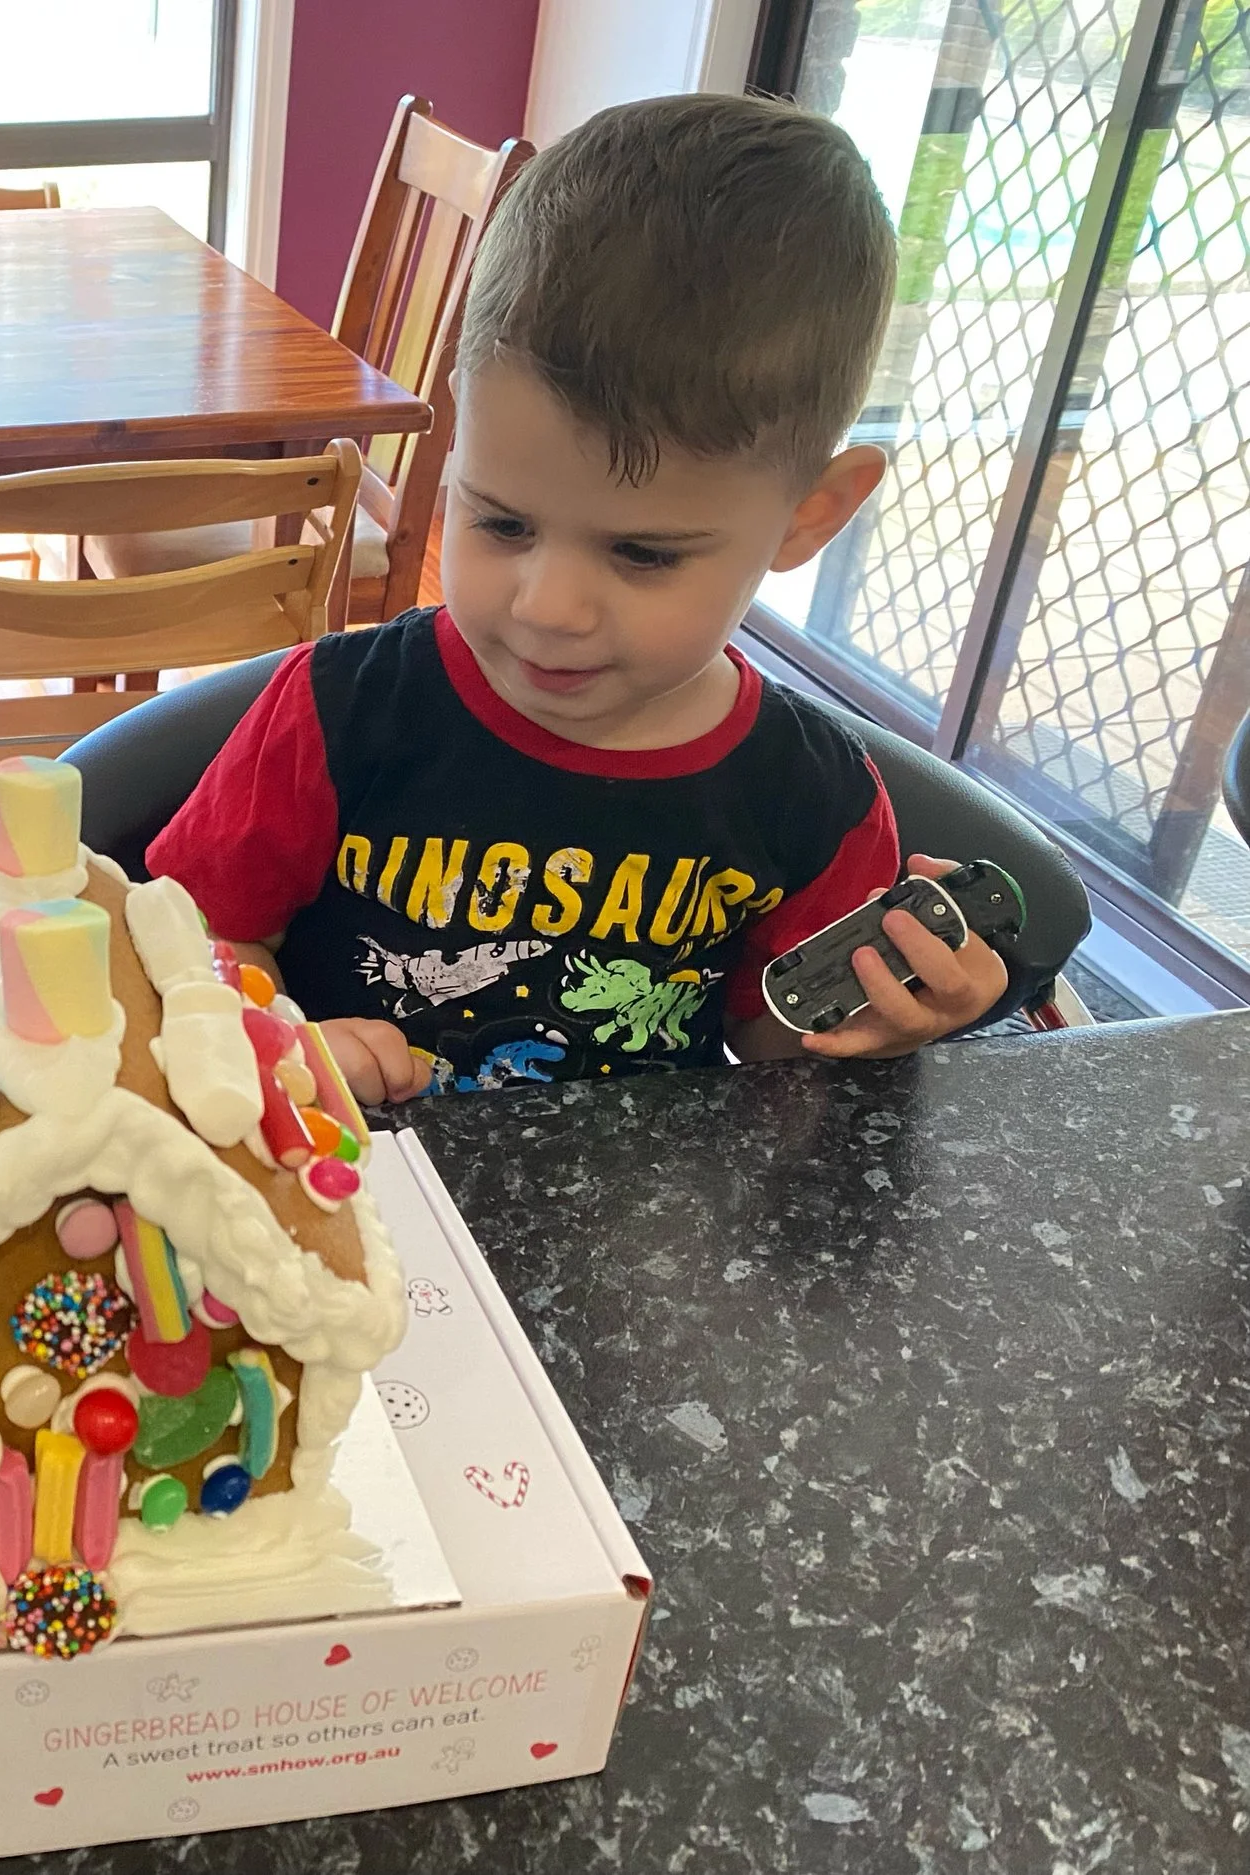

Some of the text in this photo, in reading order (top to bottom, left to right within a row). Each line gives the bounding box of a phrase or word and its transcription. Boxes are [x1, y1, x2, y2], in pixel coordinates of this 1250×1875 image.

[43, 1669, 549, 1752] GINGERBREAD HOUSE OF WELCOME
[102, 1707, 486, 1769] A sweet treat so others can eat.
[186, 1747, 402, 1784] www.smhow.org.au
